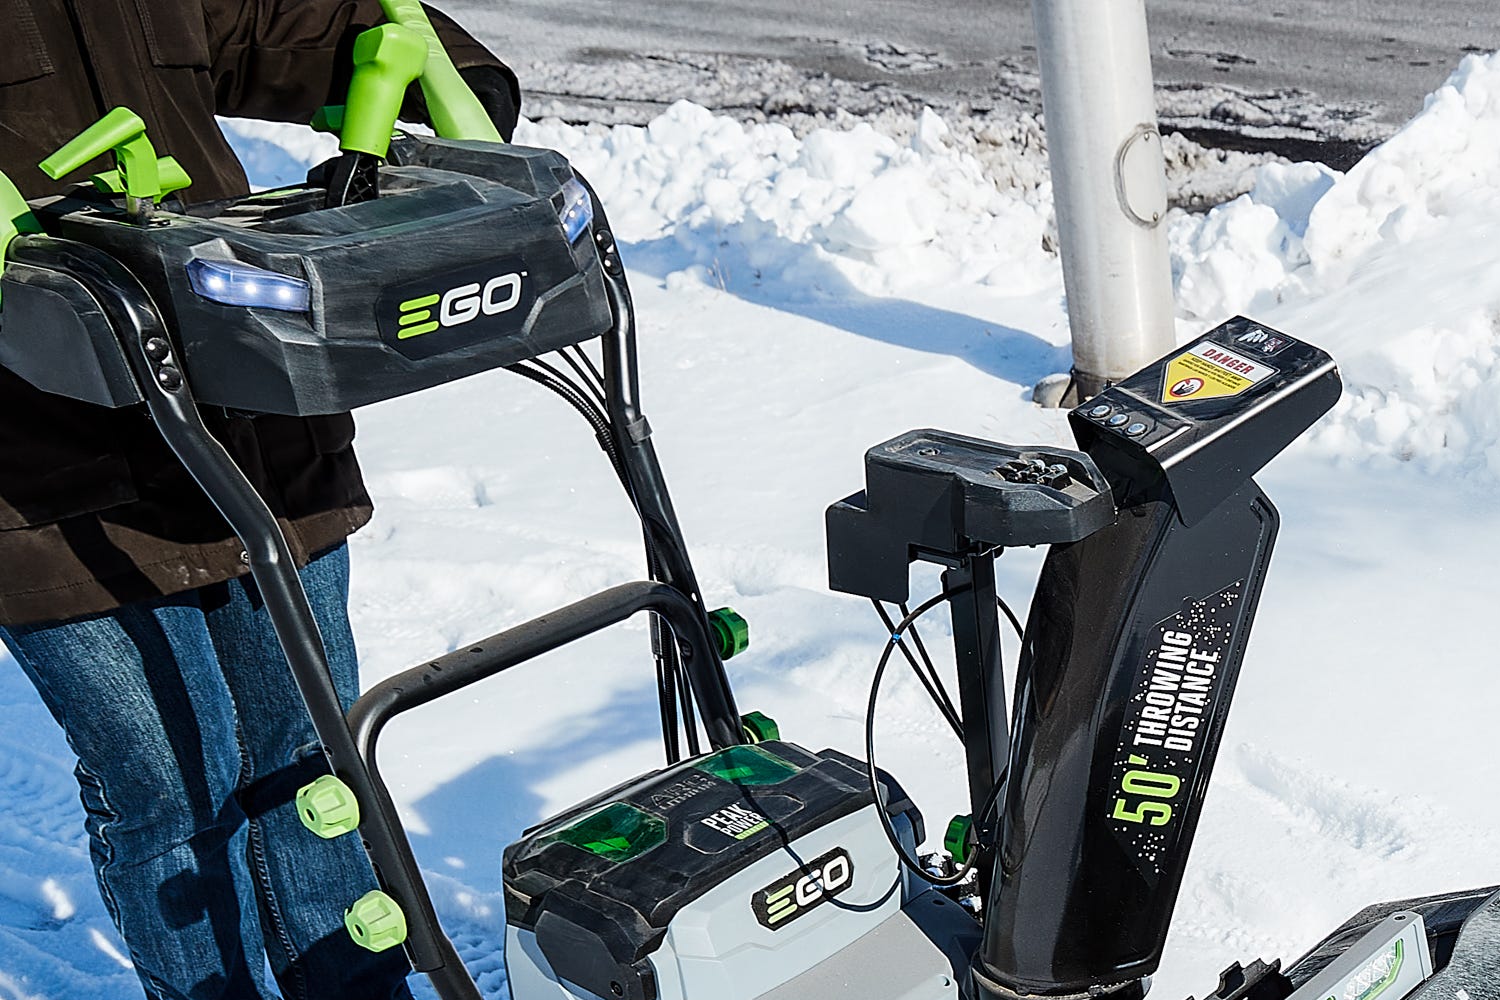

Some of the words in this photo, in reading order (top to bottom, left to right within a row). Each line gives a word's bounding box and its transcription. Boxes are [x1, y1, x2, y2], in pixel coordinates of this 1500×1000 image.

[397, 272, 522, 339] EGO
[1202, 348, 1255, 375] DANGER
[1133, 630, 1193, 747] THROWING
[1163, 648, 1219, 752] DISTANCE
[700, 803, 752, 831] PEAK
[1112, 754, 1181, 826] 50'
[720, 812, 766, 837] POWER
[766, 855, 850, 924] EGO
